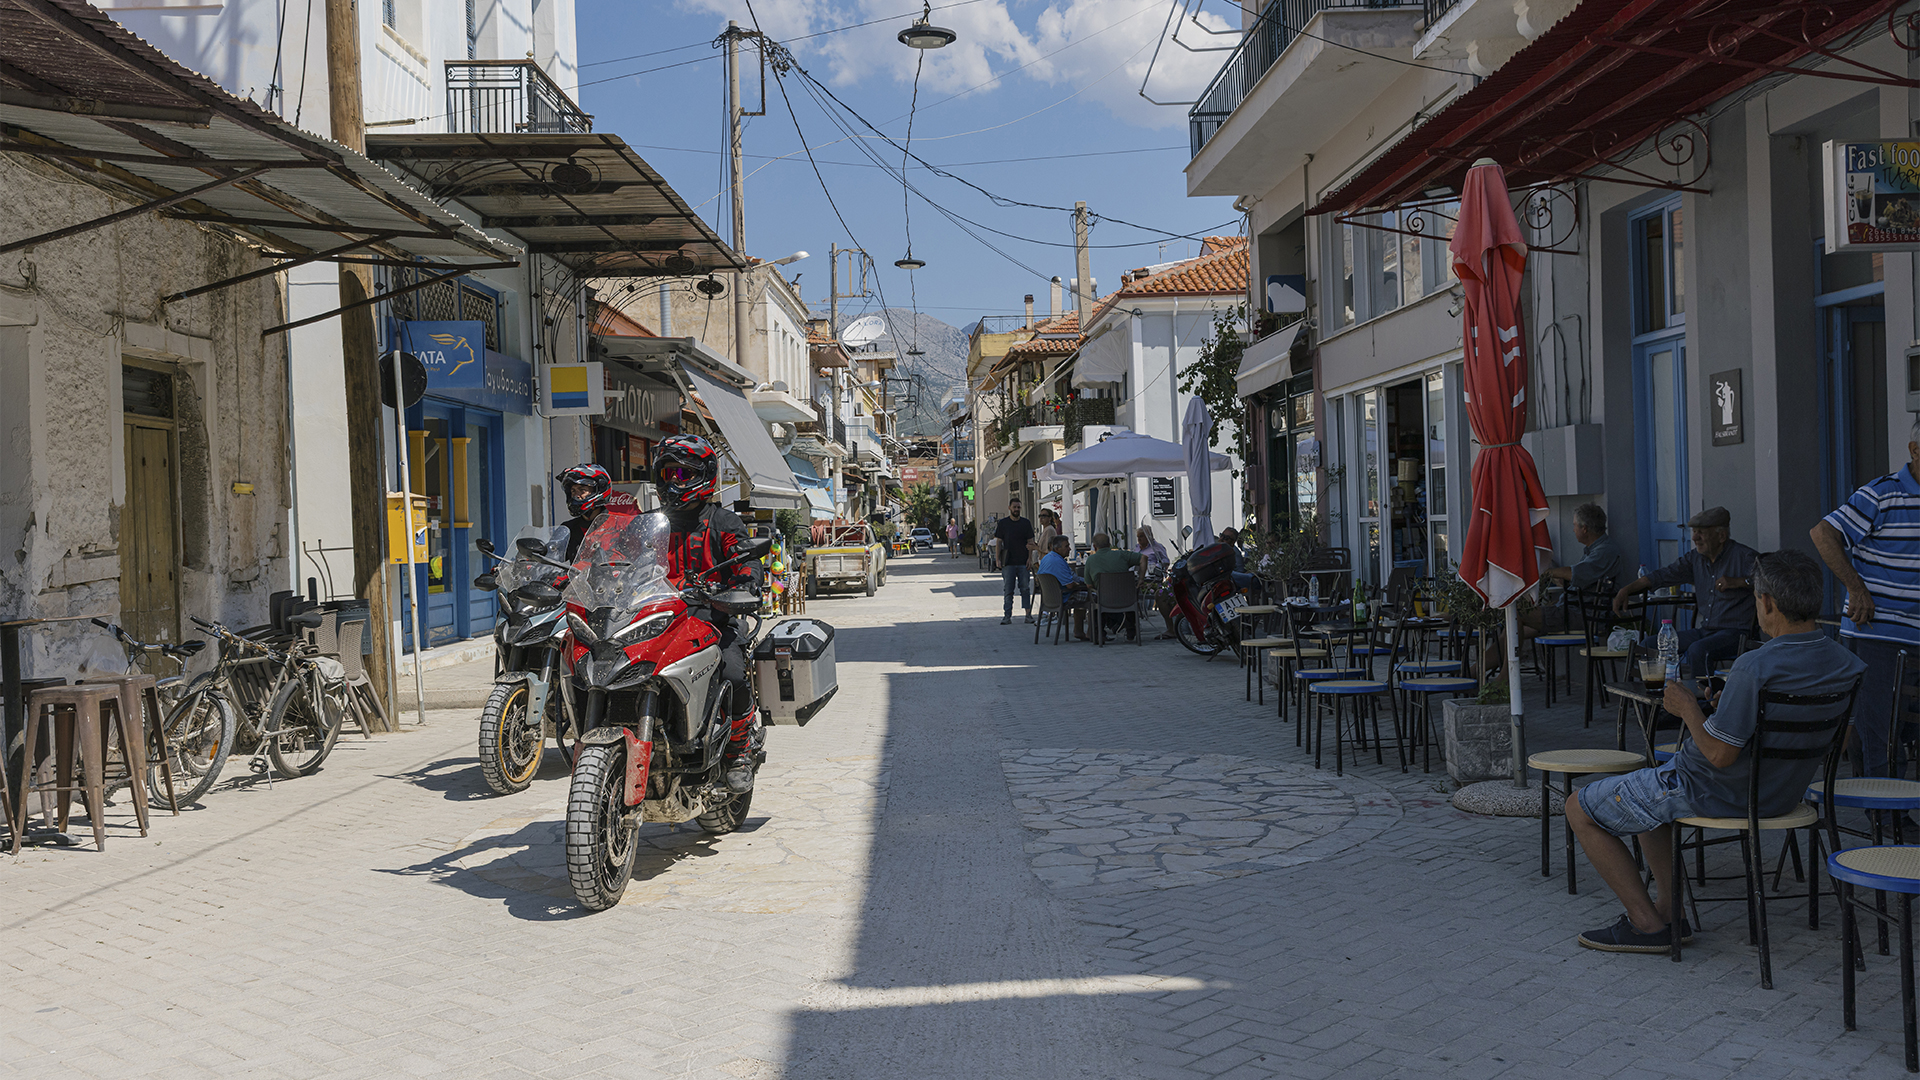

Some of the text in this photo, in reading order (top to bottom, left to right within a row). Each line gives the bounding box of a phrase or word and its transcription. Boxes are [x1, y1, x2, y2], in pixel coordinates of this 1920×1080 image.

[1847, 143, 1920, 171] Fast foo
[1868, 227, 1897, 235] 26460
[486, 368, 529, 400] αχυδρομεία
